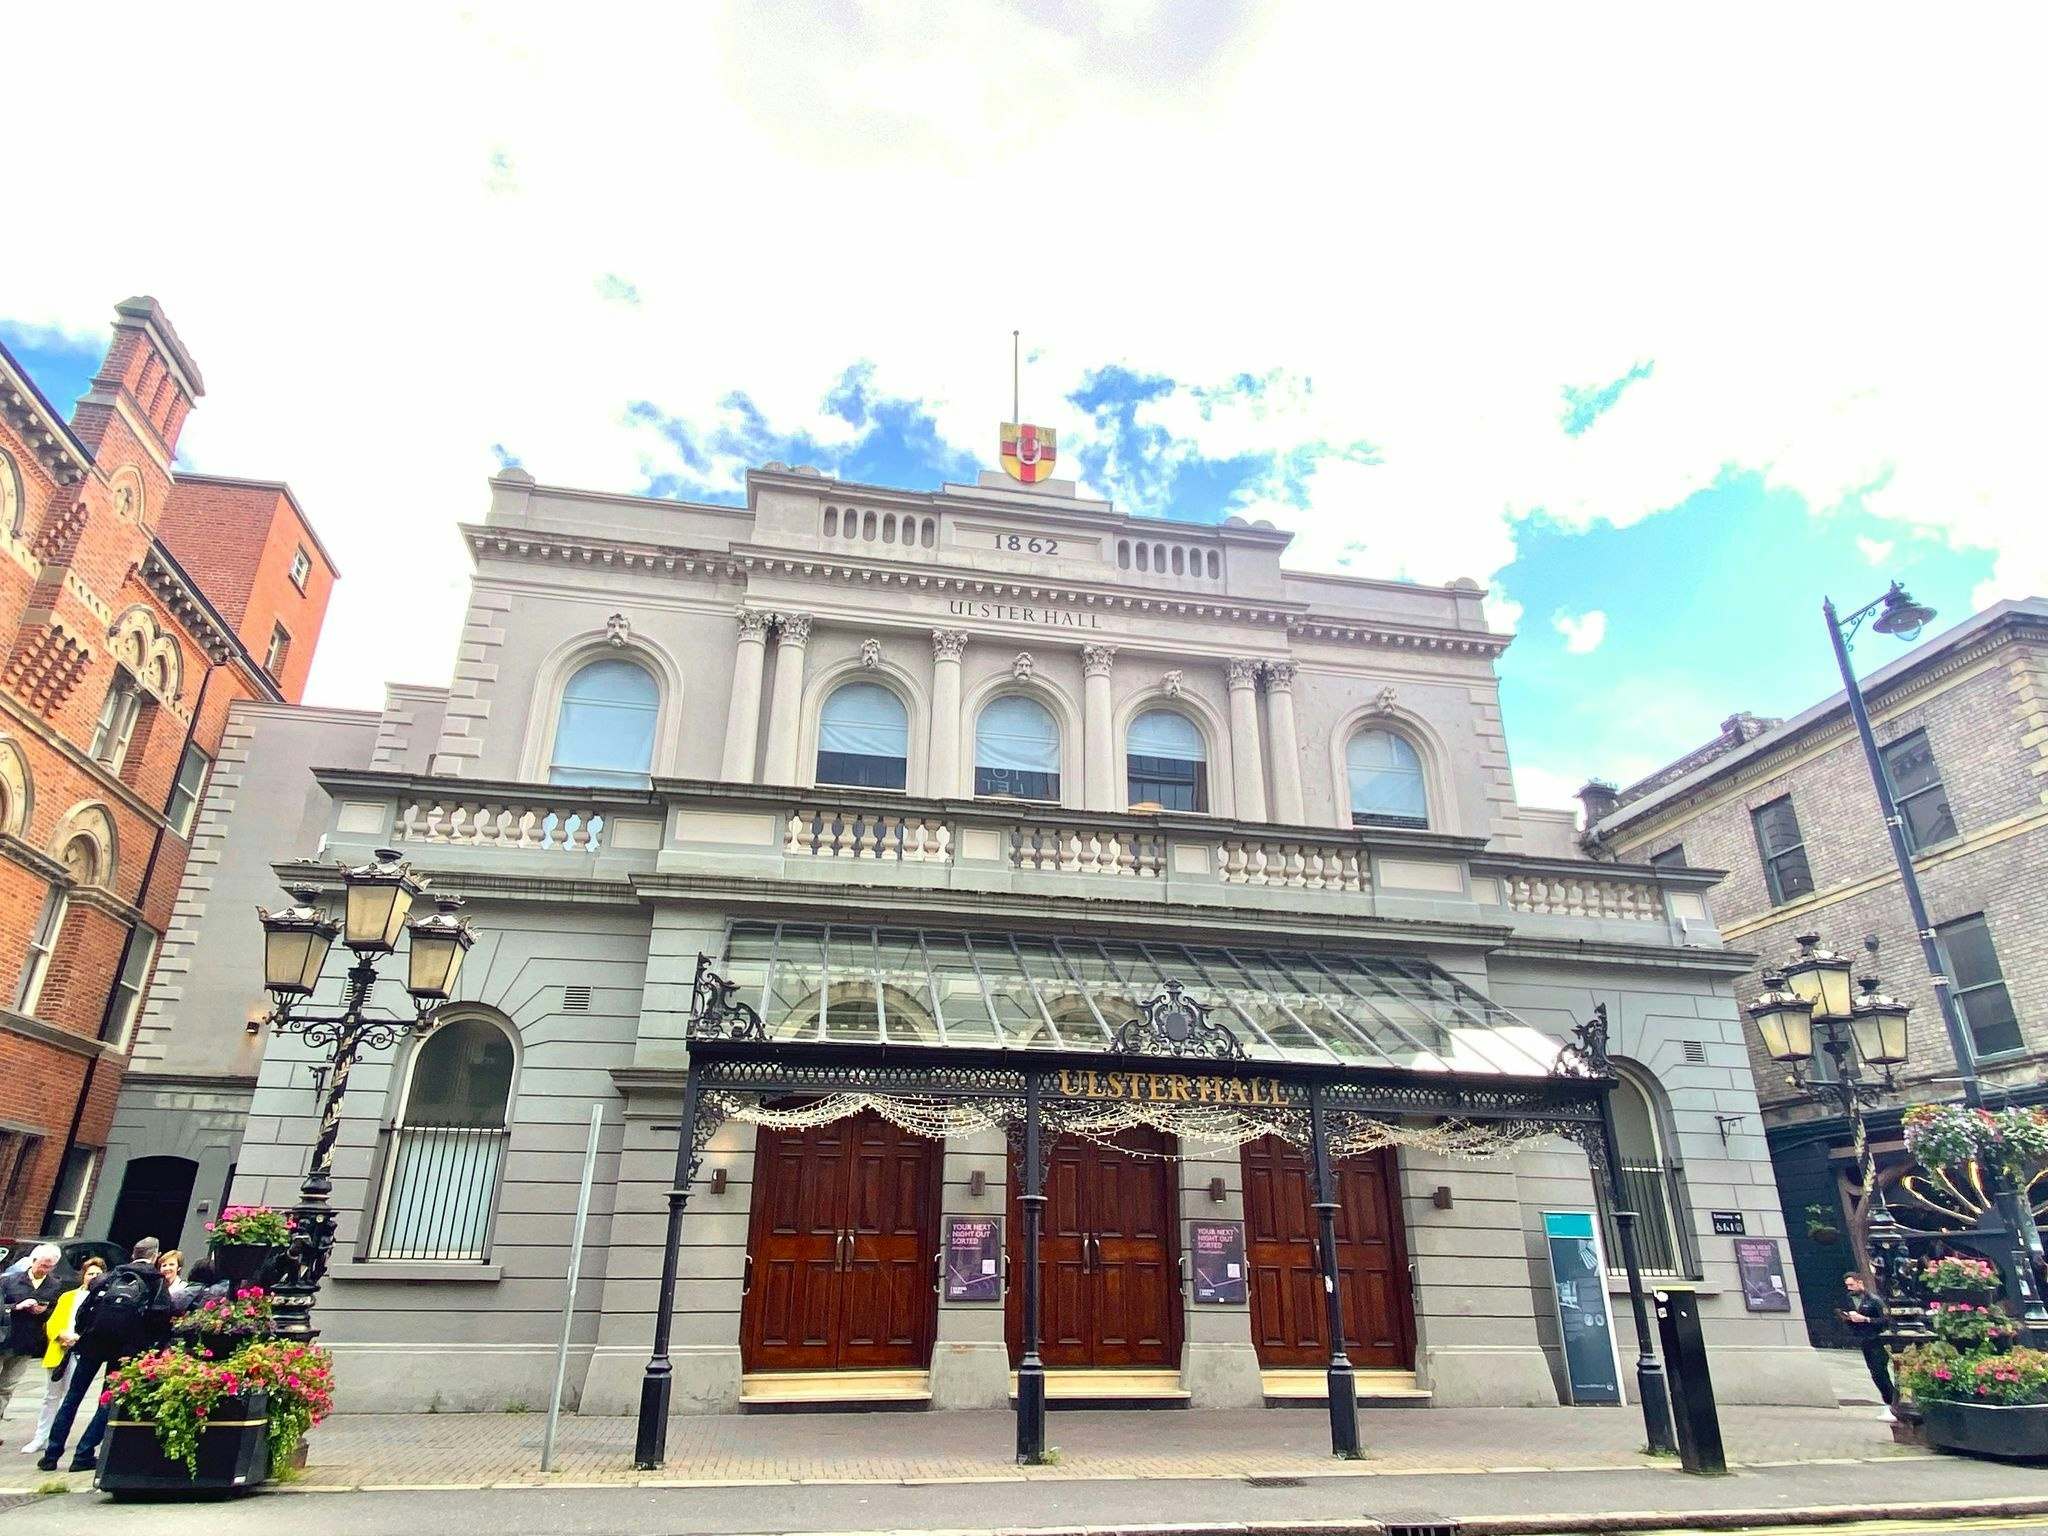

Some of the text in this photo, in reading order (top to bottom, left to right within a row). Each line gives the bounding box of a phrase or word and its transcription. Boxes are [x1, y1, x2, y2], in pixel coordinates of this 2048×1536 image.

[994, 534, 1058, 555] 1862
[950, 600, 1102, 629] ULSTER HALL
[1059, 1069, 1290, 1105] ULSTER HALL
